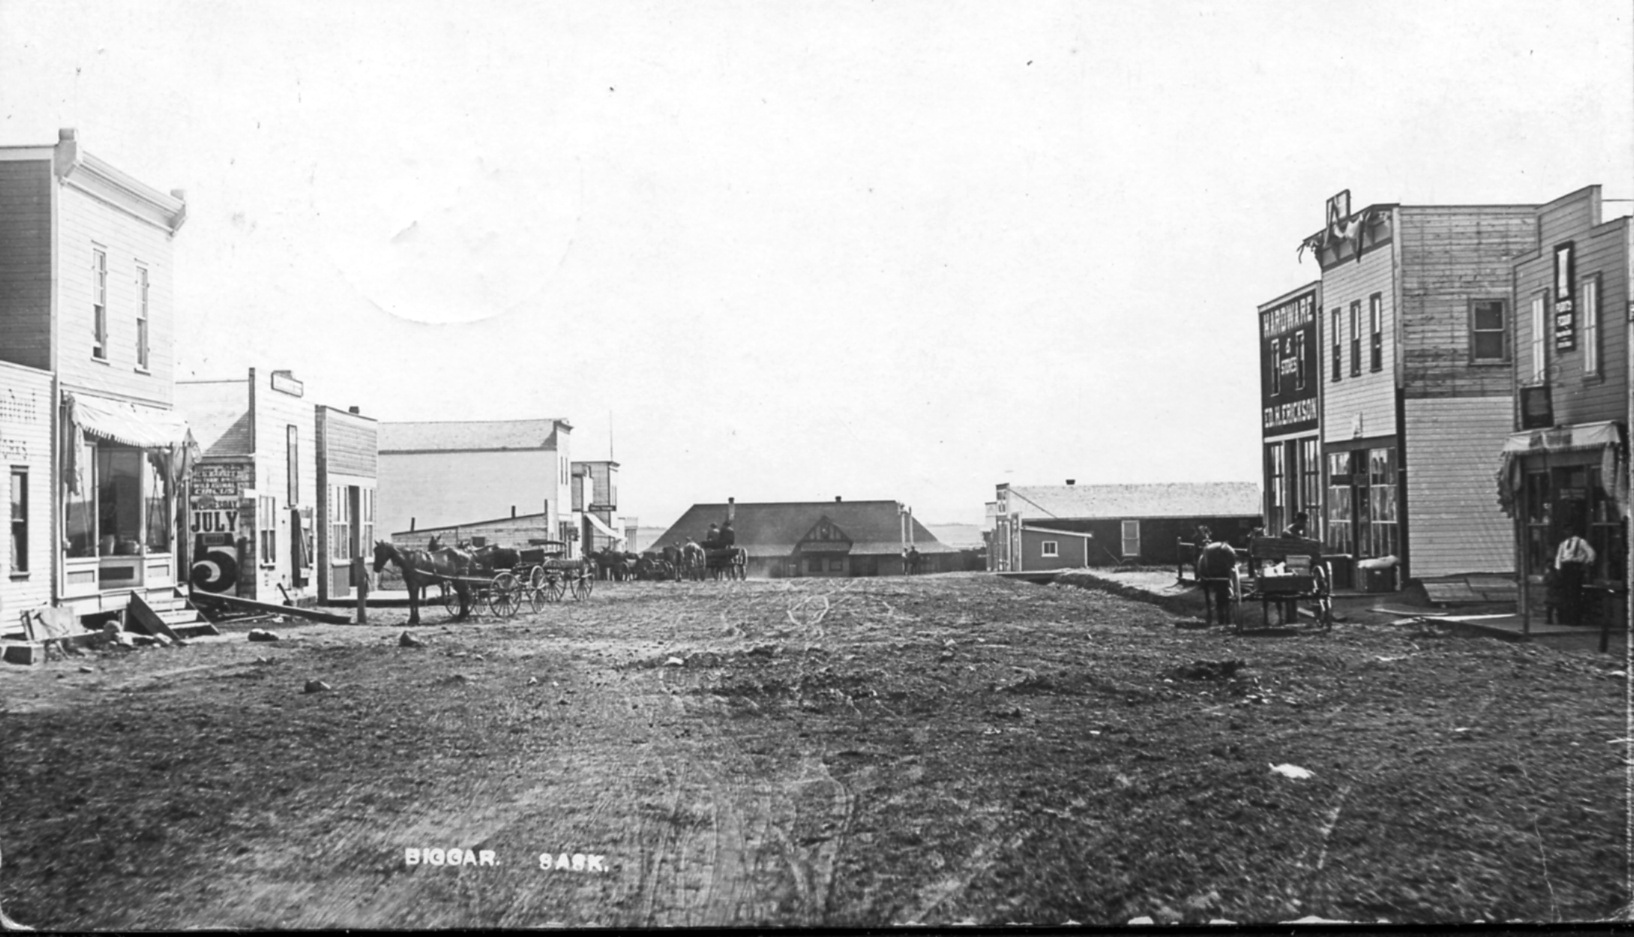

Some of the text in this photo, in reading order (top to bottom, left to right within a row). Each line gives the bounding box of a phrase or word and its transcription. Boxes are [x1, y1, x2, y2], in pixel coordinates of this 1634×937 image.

[1263, 294, 1313, 338] HARDWARE
[194, 488, 236, 496] CIRCUS
[191, 510, 238, 533] JULY
[192, 532, 237, 594] 5
